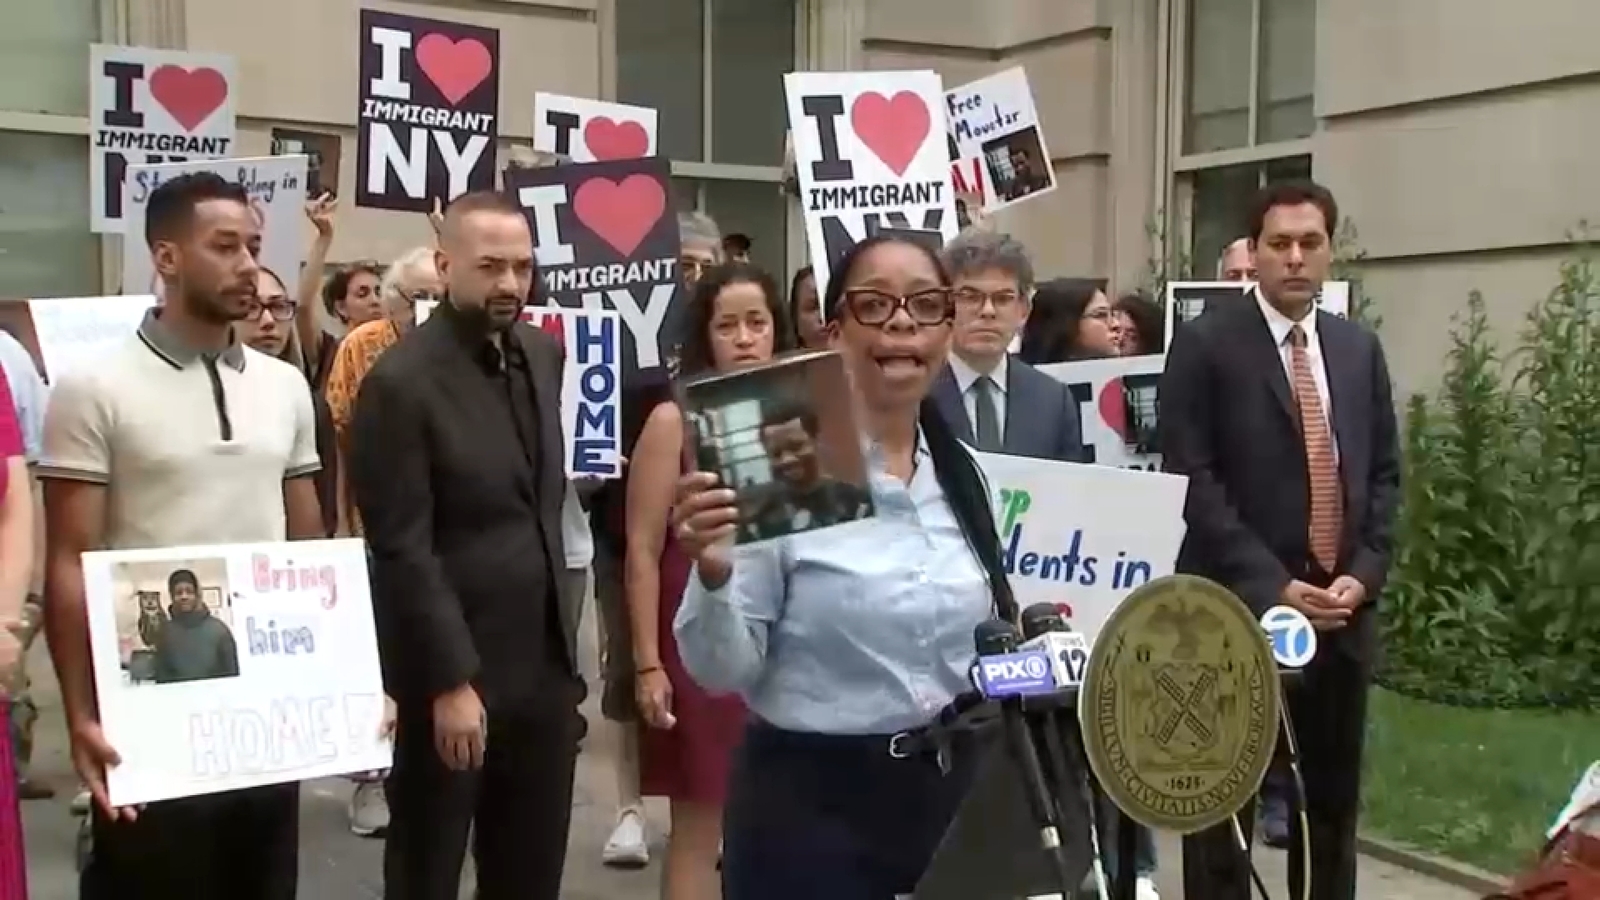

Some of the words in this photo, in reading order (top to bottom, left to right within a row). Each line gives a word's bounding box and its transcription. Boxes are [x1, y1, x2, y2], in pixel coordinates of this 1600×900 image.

[103, 61, 144, 127] I
[371, 26, 411, 99] I
[362, 99, 494, 132] IMMIGRANT
[802, 95, 854, 181] I
[946, 94, 983, 117] Free
[96, 130, 231, 154] IMMIGRANT
[367, 122, 489, 203] NY
[519, 184, 575, 266] I
[809, 182, 944, 210] IMMIGRANT
[573, 316, 616, 474] HOME
[251, 552, 338, 610] Bring
[1002, 523, 1098, 586] dents
[1112, 551, 1150, 590] in
[246, 616, 315, 656] him
